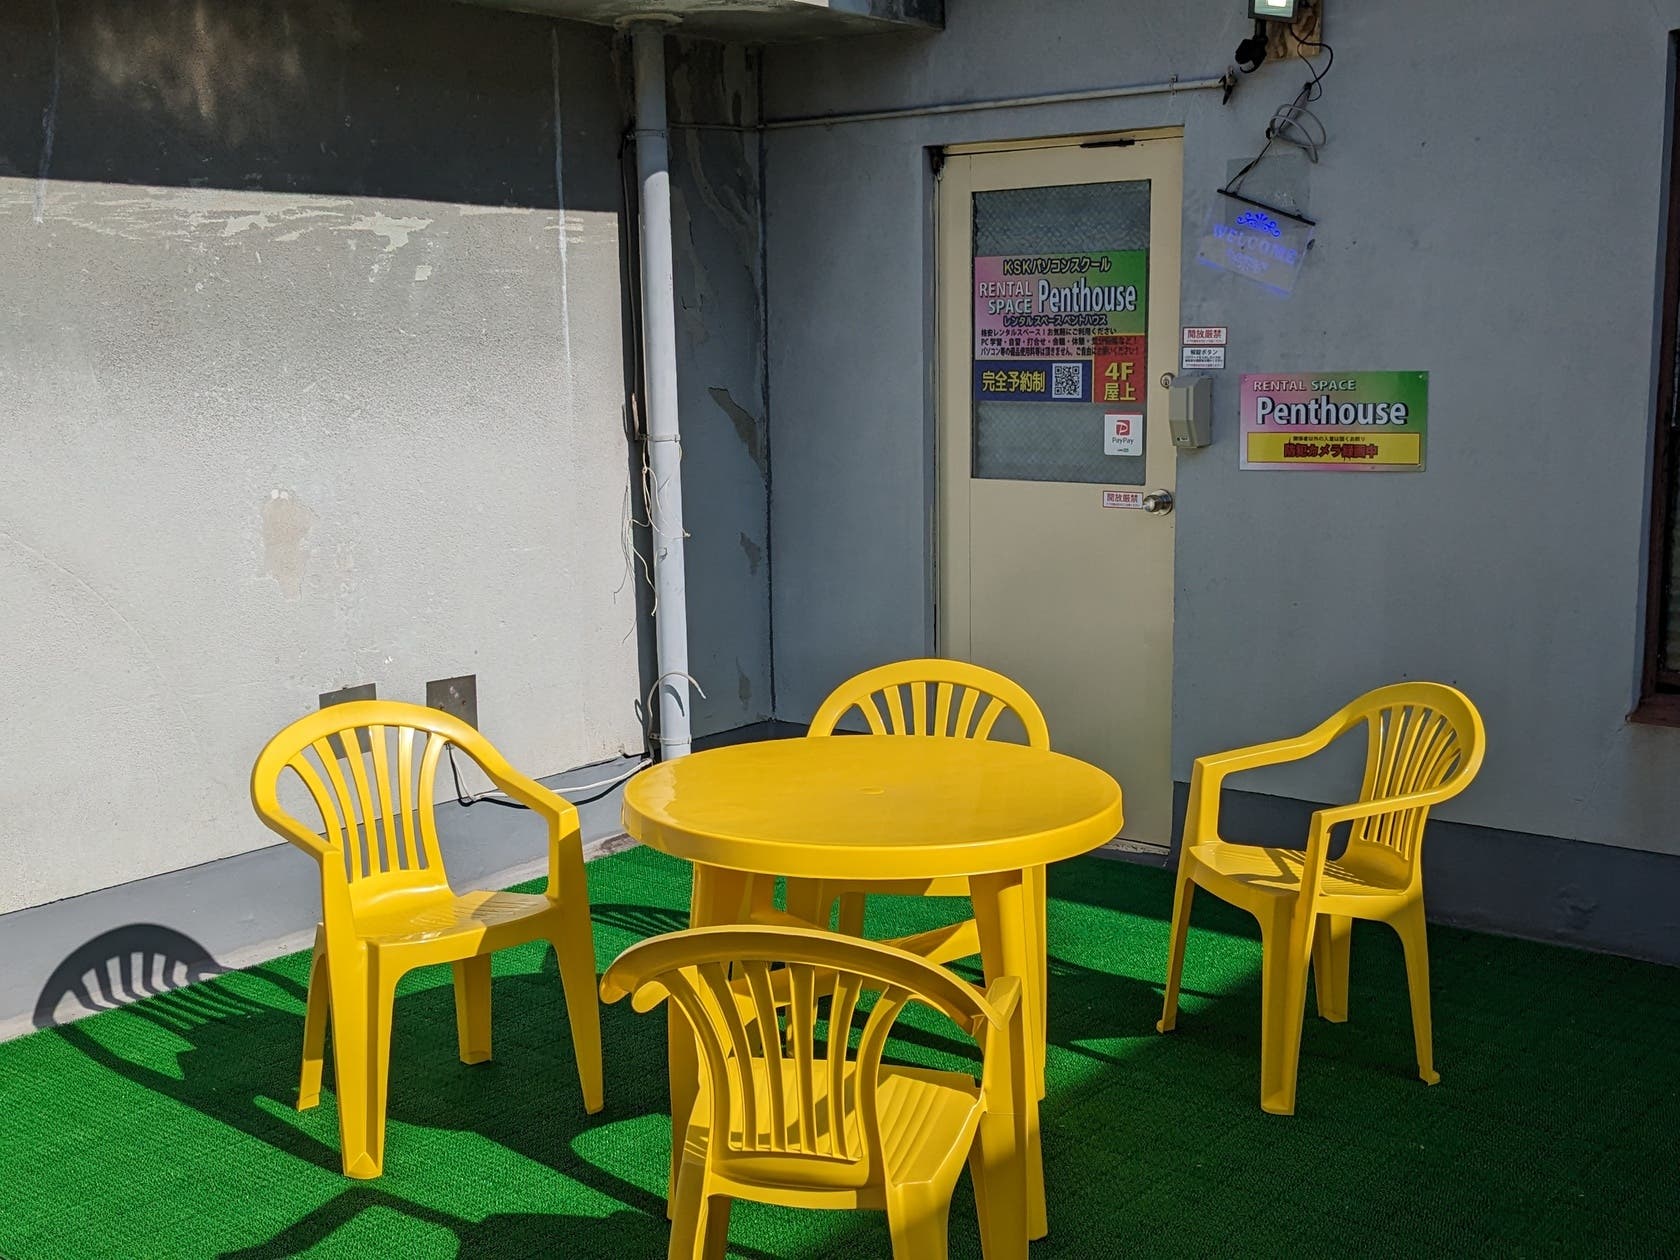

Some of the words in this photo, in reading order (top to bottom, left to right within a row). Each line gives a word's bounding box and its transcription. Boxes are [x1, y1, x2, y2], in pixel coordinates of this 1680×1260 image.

[1213, 224, 1297, 265] WELCOME
[1003, 256, 1111, 275] KSKパソコンスクール
[979, 281, 1033, 297] RENTAL
[1037, 277, 1138, 313] Penthouse
[988, 298, 1032, 314] SPACE
[1104, 362, 1134, 380] 4F
[982, 370, 1046, 392] 完全予約制
[1253, 380, 1306, 392] RENTAL
[1310, 379, 1356, 391] SPACE
[1103, 383, 1136, 401] 屋上
[1255, 394, 1409, 426] Penthouse
[1111, 436, 1135, 446] PayPay
